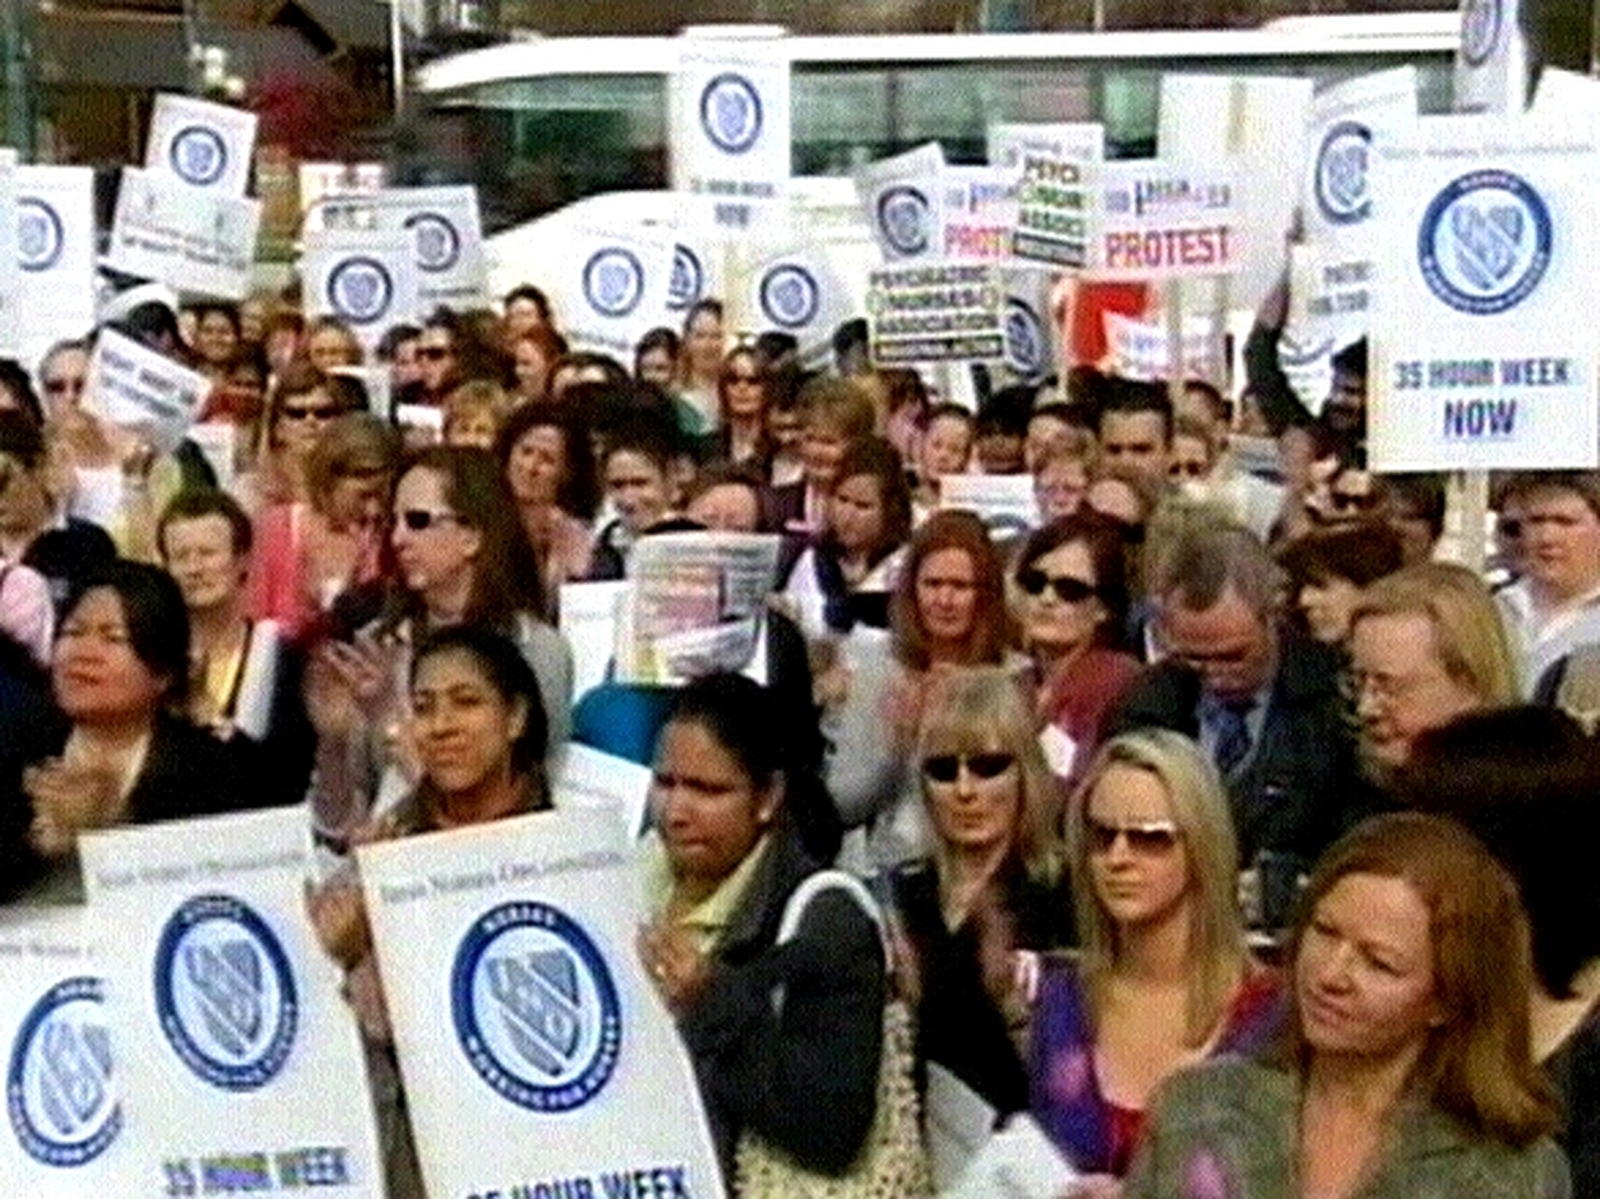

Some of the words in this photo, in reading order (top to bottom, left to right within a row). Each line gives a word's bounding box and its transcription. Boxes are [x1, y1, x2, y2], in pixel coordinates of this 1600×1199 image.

[945, 224, 1010, 257] PROT
[1106, 225, 1231, 268] PROTEST
[1394, 360, 1422, 390] 35
[1428, 358, 1495, 388] HOUR
[1500, 356, 1570, 386] WEEK
[1444, 398, 1518, 438] NOW
